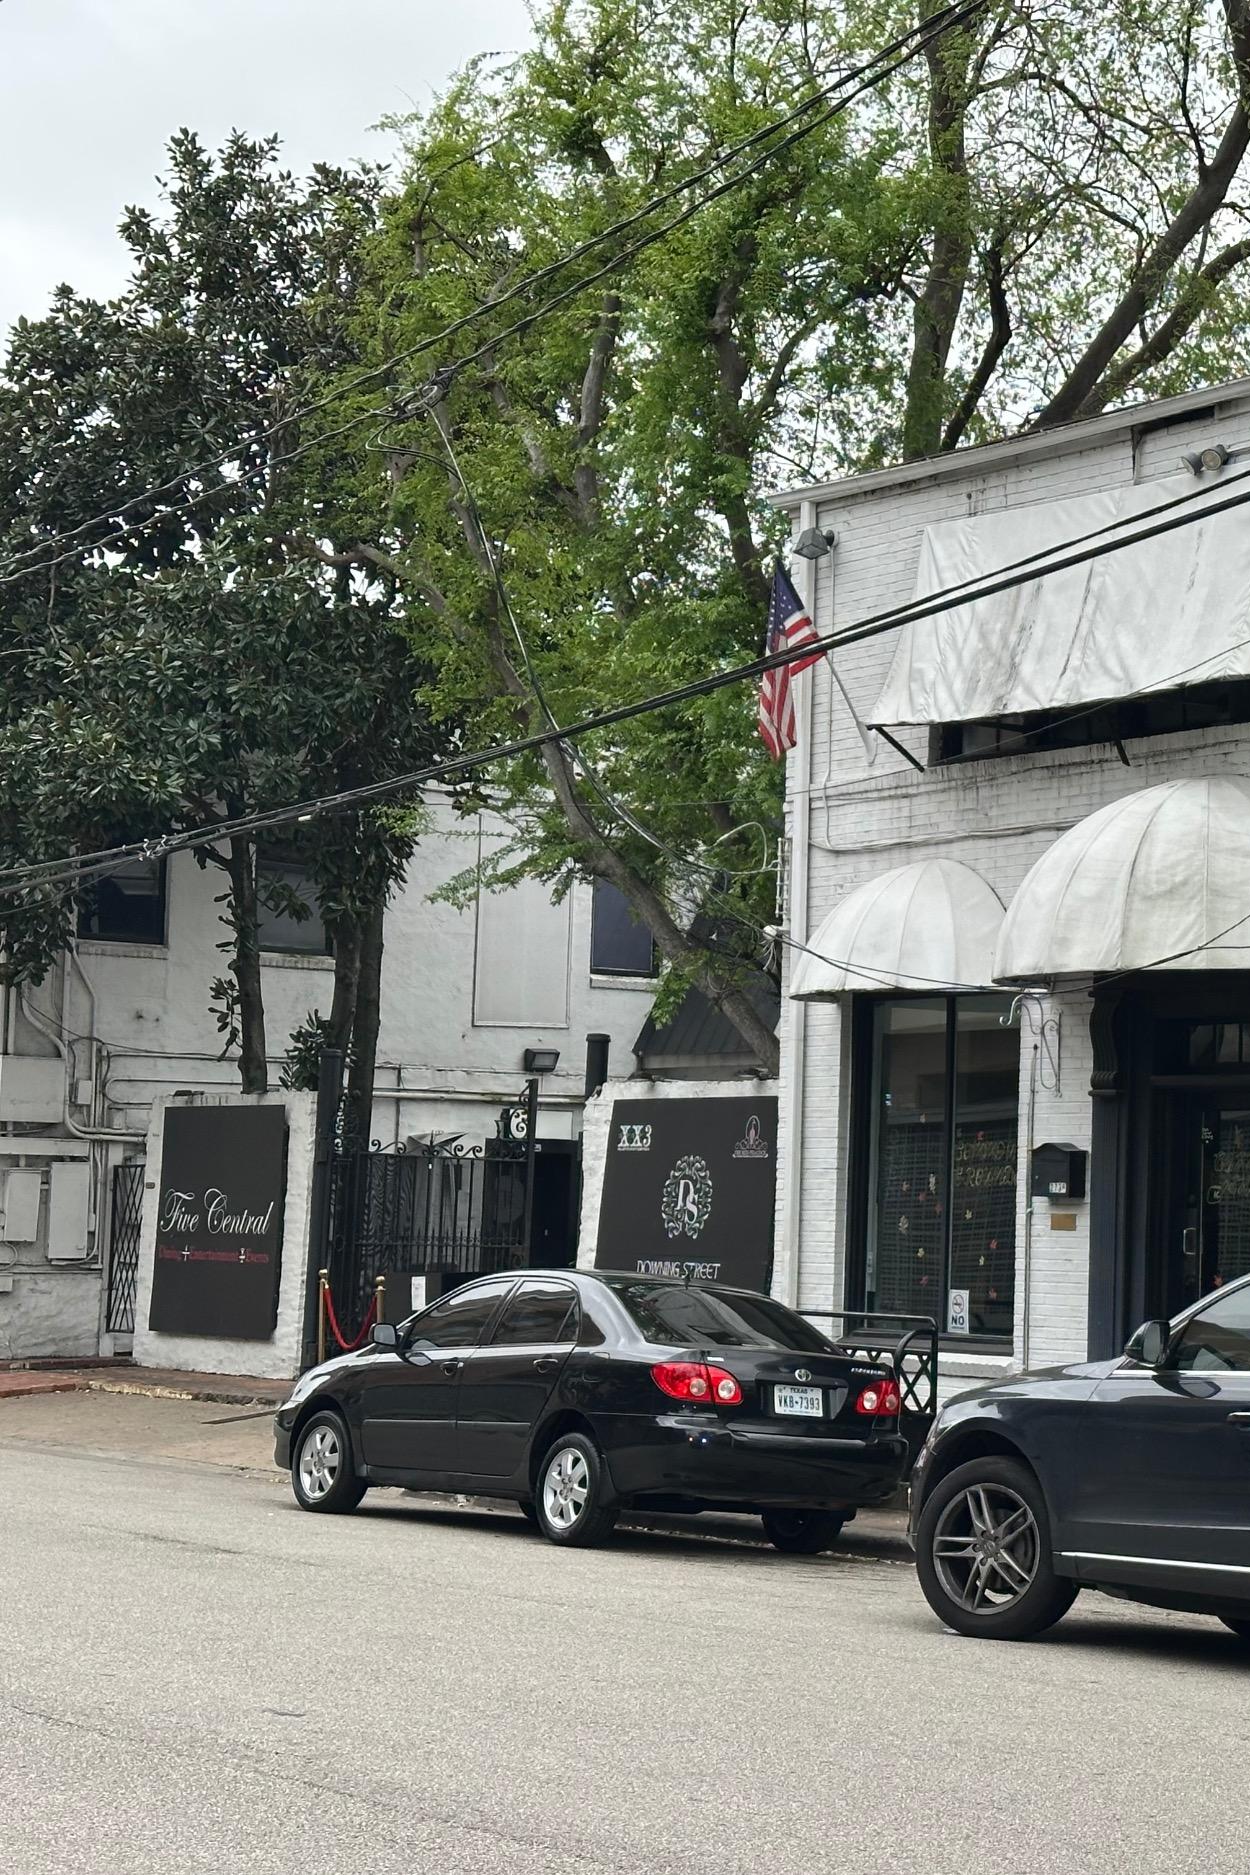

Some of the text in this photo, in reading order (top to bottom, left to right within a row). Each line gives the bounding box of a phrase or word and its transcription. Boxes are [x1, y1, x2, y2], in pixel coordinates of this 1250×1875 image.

[160, 1188, 274, 1235] Five Central
[636, 1259, 721, 1280] DOWNING STREET
[951, 1315, 965, 1326] NO
[790, 1387, 808, 1395] TEXAS
